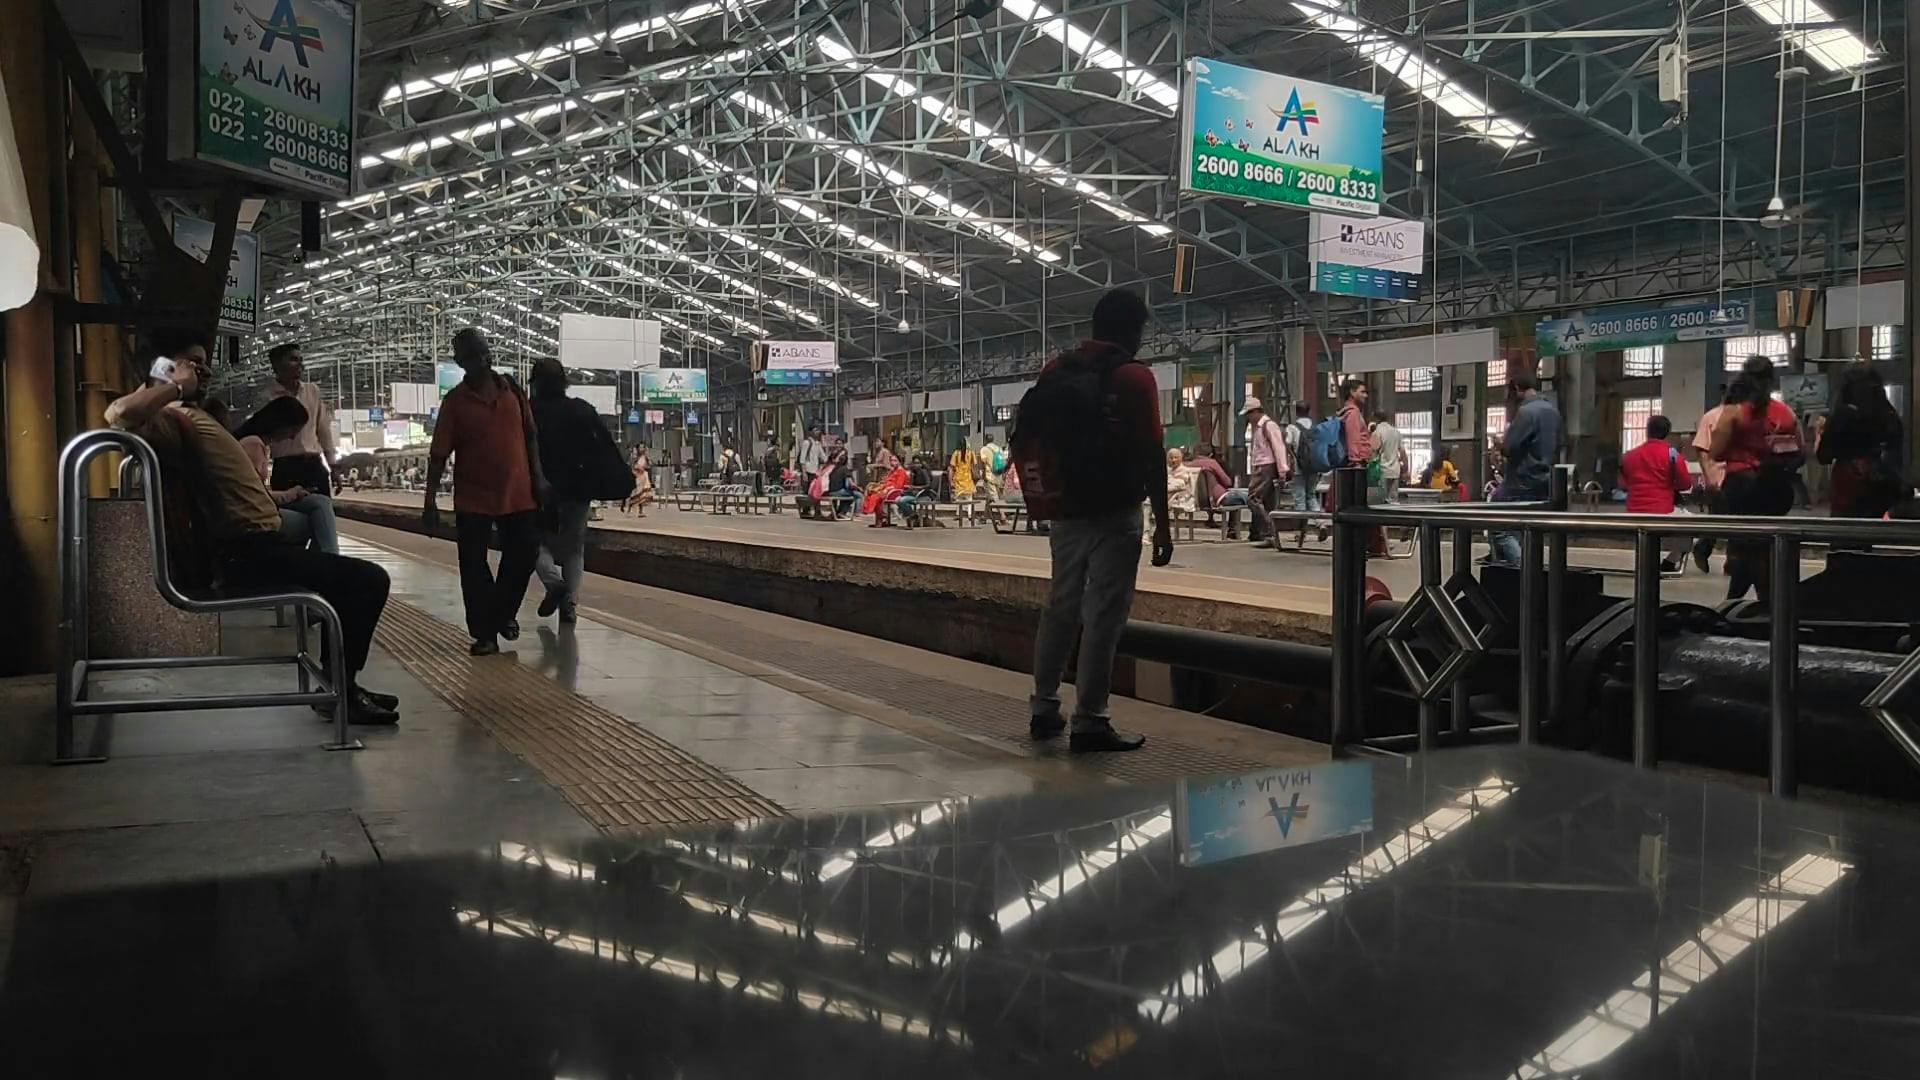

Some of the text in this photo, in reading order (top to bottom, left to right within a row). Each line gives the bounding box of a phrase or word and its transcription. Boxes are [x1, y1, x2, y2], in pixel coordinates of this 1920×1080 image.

[242, 56, 321, 104] ALAKH
[209, 88, 244, 118] 022
[264, 107, 349, 151] 26008333
[209, 113, 244, 141] 022
[264, 131, 348, 173] 26008666
[1263, 136, 1320, 160] ALAKH
[1197, 154, 1239, 178] 2600
[1243, 163, 1284, 185] 8666
[1297, 171, 1335, 193] 2600
[1339, 179, 1376, 200] 8333
[1355, 228, 1405, 250] ABANS
[1590, 320, 1621, 336] 2600
[1625, 317, 1658, 332] 8666
[1670, 312, 1704, 328] 2600
[1709, 307, 1745, 322] 833
[783, 347, 820, 358] ABANS
